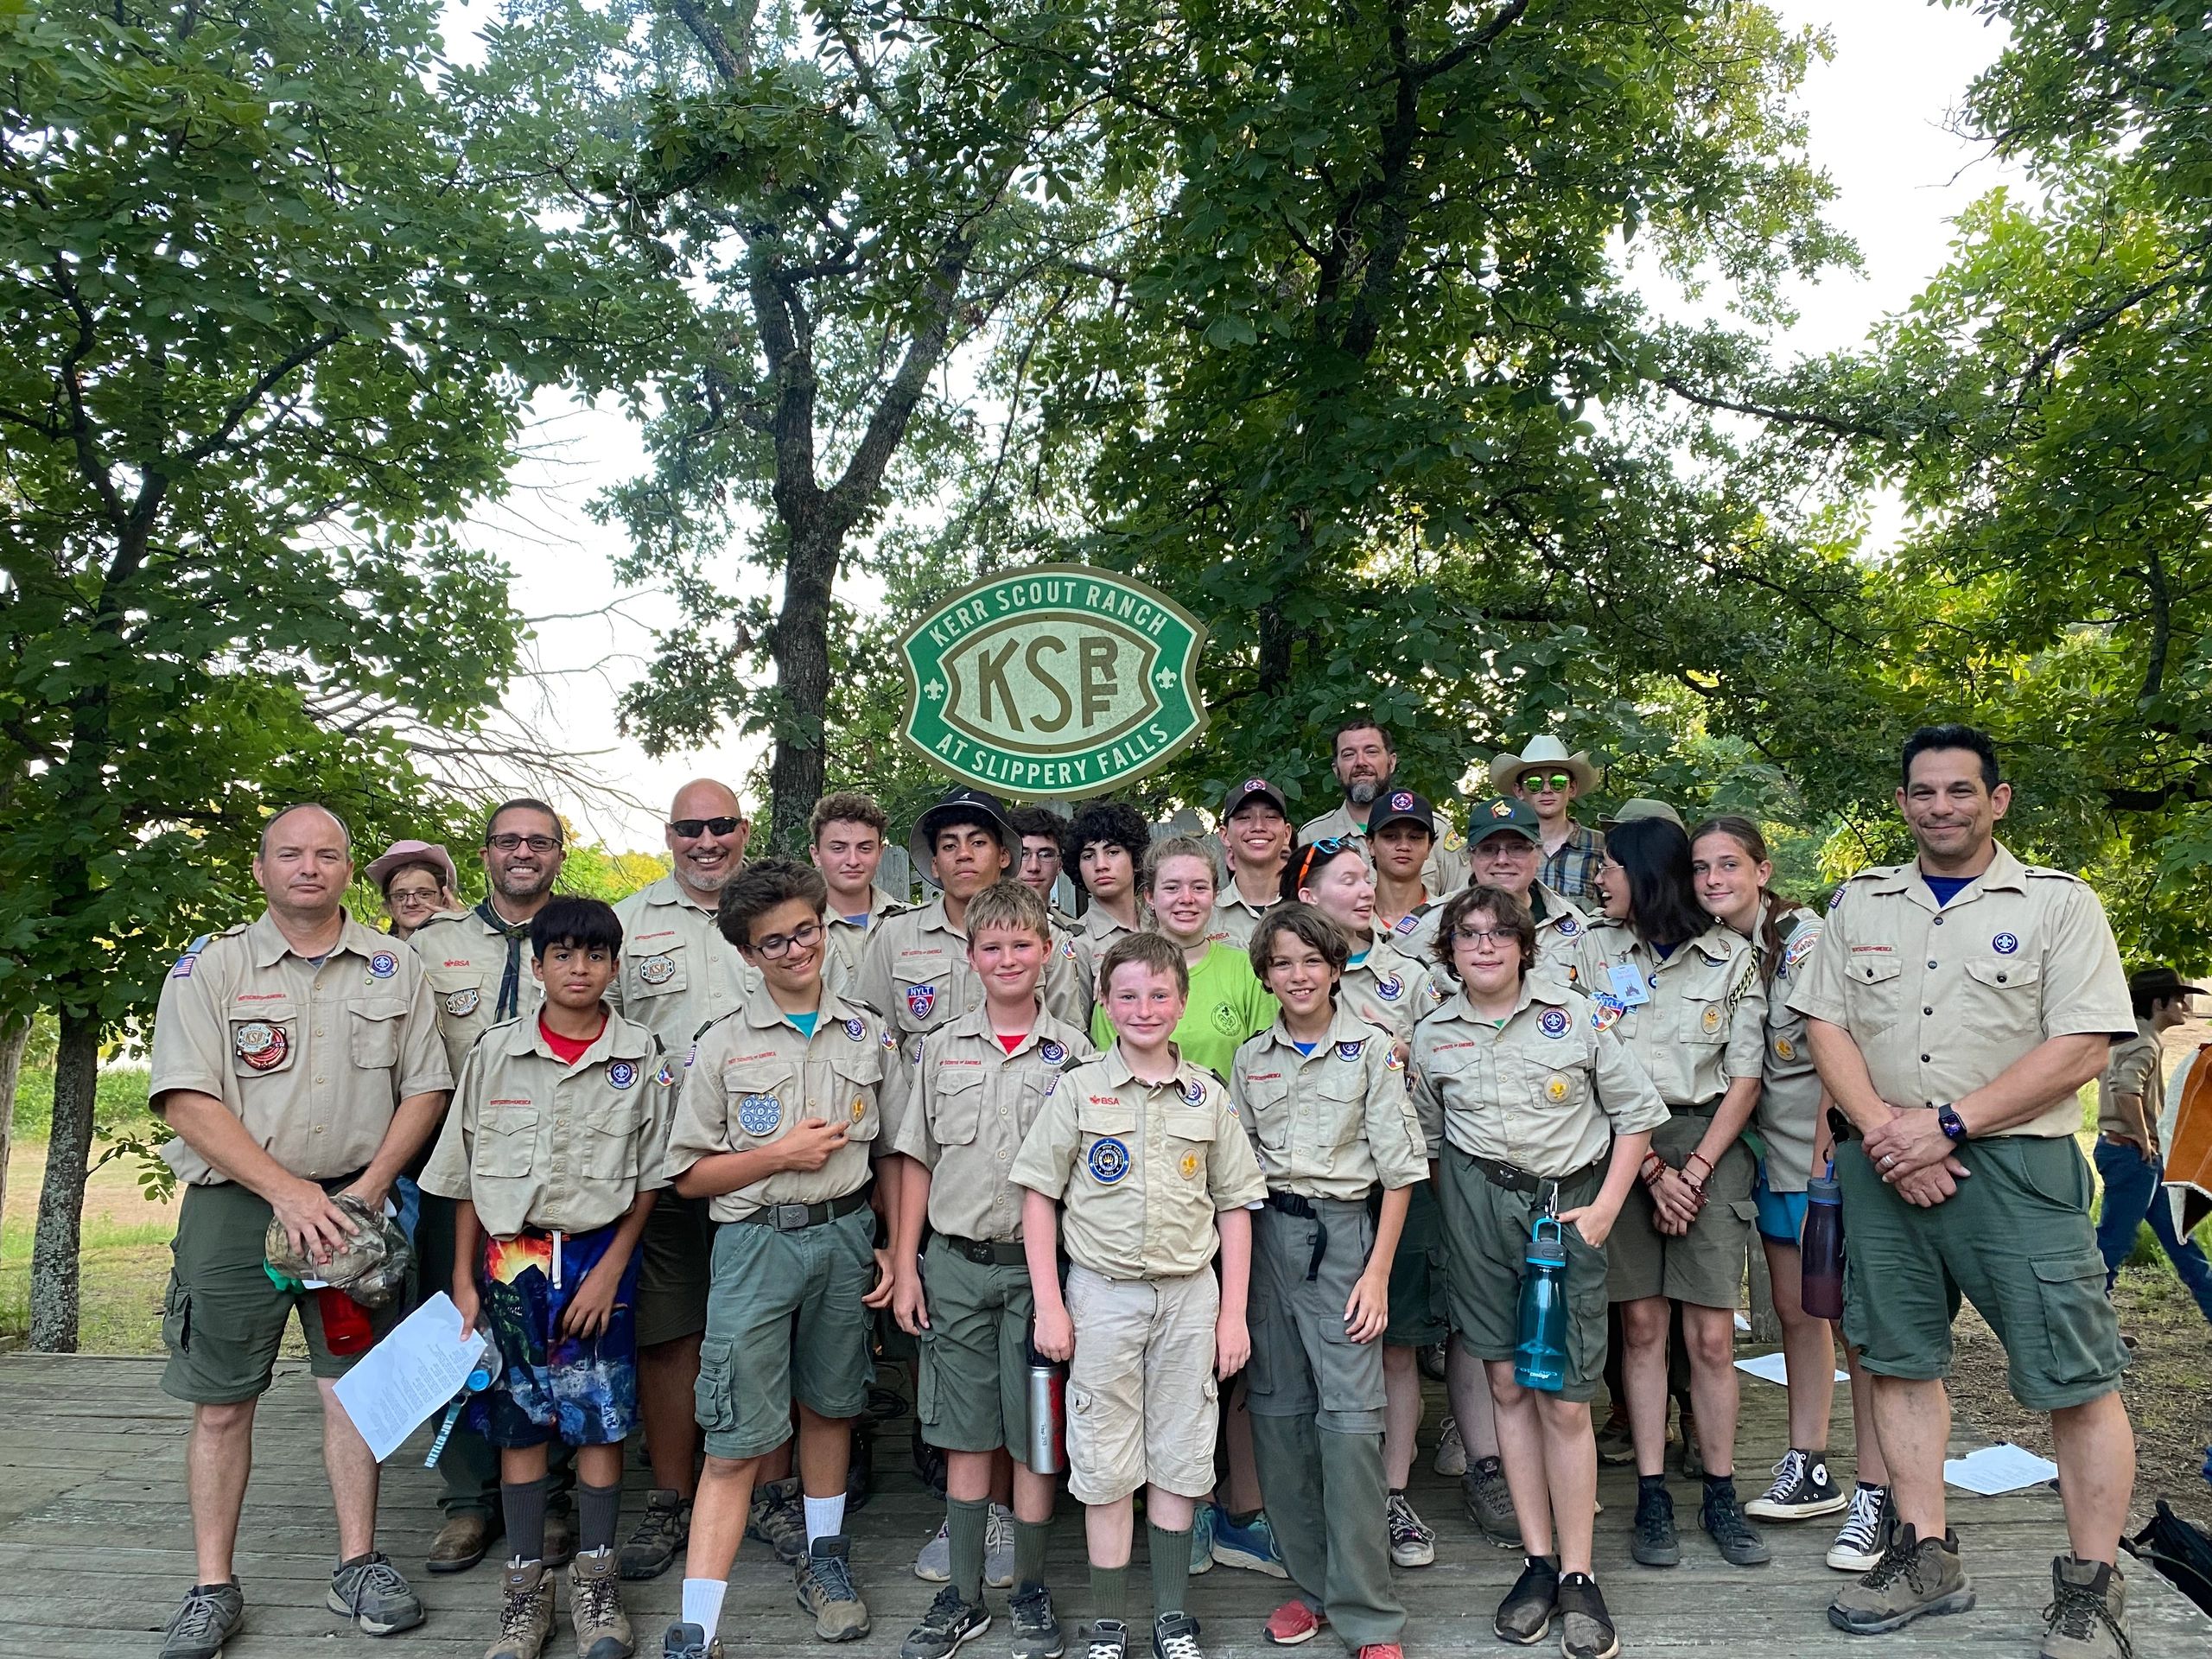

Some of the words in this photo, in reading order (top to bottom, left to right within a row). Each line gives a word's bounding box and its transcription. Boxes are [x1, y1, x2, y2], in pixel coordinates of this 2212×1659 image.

[928, 598, 989, 648] KERR
[995, 581, 1077, 612] SCOUT
[1085, 585, 1169, 636] RANCH
[935, 732, 969, 762] AT
[971, 749, 1089, 786] SLIPPERY
[1096, 722, 1169, 777] FALLS
[910, 987, 931, 996] NYLT
[1101, 1096, 1120, 1105] BSA
[423, 1434, 448, 1468] BOTTLED
[441, 1416, 454, 1435] JOY
